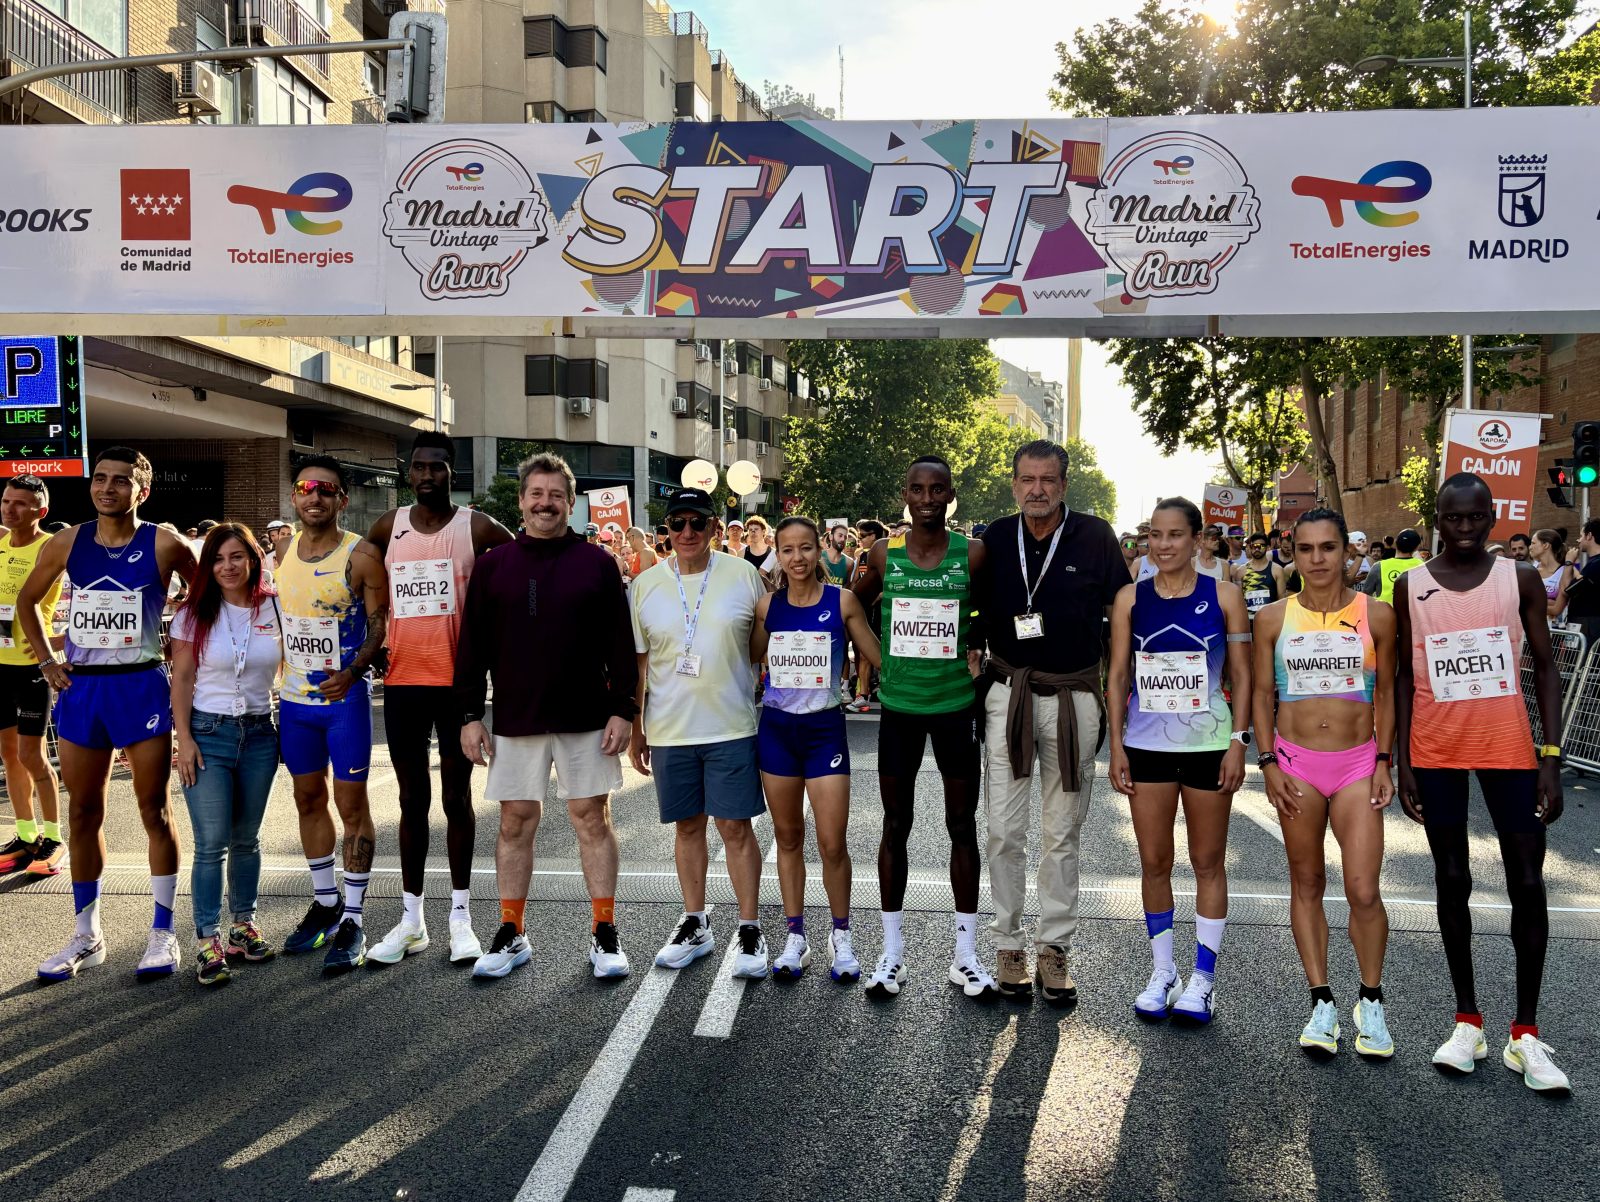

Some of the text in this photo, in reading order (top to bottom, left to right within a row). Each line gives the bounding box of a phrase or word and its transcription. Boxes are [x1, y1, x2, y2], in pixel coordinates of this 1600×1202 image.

[446, 184, 485, 192] TotalEnergies
[404, 199, 526, 228] Madrid
[562, 161, 1068, 275] START
[1109, 194, 1237, 223] Madrid
[0, 209, 93, 232] OOKS
[430, 230, 499, 251] Vintage
[1135, 225, 1208, 248] Vintage
[120, 247, 192, 257] Comunidad
[227, 248, 354, 268] TotalEnergies
[1289, 241, 1431, 262] TotalEnergies
[1468, 239, 1570, 263] MADRID
[120, 260, 191, 271] de Madrid
[427, 253, 502, 293] Run
[1132, 250, 1211, 291] Run
[5, 346, 43, 398] P
[5, 410, 46, 424] LIBRE
[49, 424, 62, 438] P
[12, 461, 63, 474] telpark
[1461, 456, 1521, 477] CAJÓN
[597, 507, 622, 519] CAJÓN
[1210, 507, 1237, 519] CAJÓN
[1492, 498, 1528, 521] TE
[395, 580, 449, 598] PACER 2
[529, 578, 537, 616] BROOKS
[73, 611, 137, 630] CHAKIR
[893, 620, 956, 638] KWIZERA
[286, 633, 333, 654] CARRO
[770, 655, 828, 667] OUHADDOU
[1286, 656, 1361, 671] NAVARRETE
[1434, 653, 1505, 678] PACER 1
[1139, 675, 1204, 690] MAAYOUF
